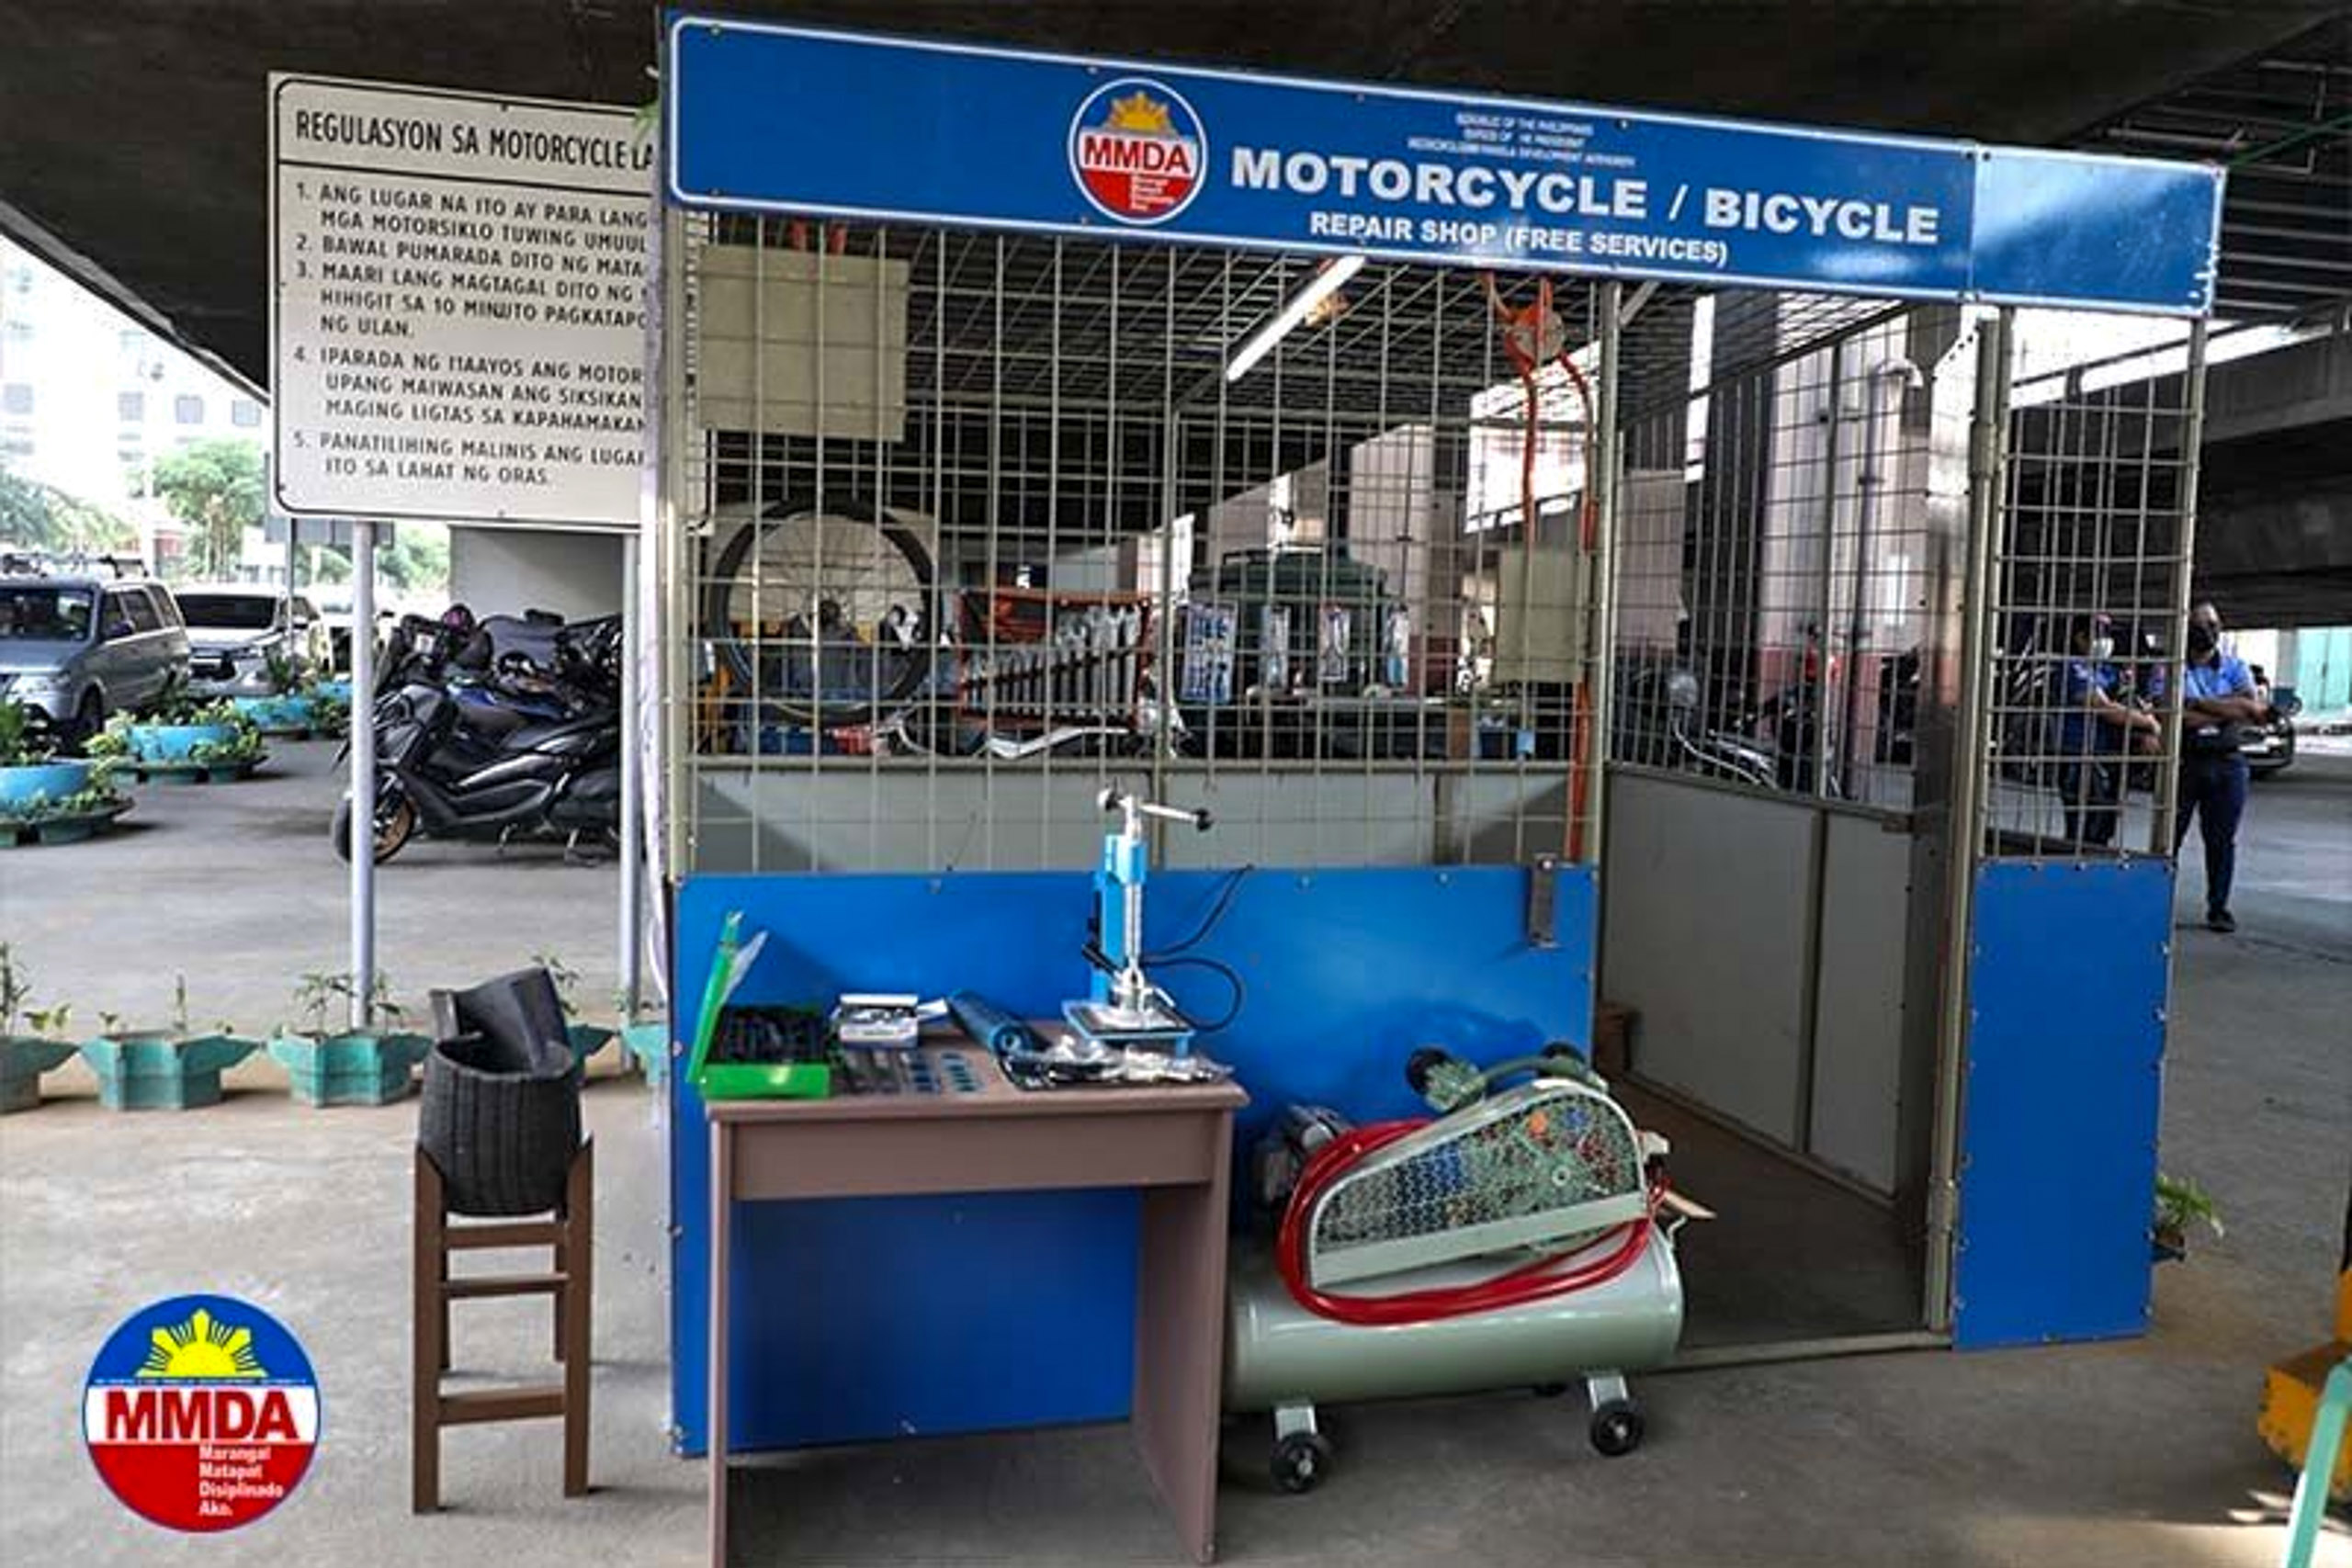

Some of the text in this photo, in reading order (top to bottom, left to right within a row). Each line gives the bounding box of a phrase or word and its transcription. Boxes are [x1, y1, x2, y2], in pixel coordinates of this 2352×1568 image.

[296, 110, 441, 152] REGULASYON
[452, 124, 480, 154] SA
[490, 129, 626, 168] MOTORCYCLE
[1083, 136, 1191, 173] MMDA
[320, 184, 362, 205] ANG
[369, 188, 433, 210] LUGAR
[441, 195, 467, 213] NA
[476, 197, 505, 217] ITO
[514, 202, 537, 220] AY
[544, 204, 593, 224] PARA
[599, 210, 648, 229] LANG
[1231, 146, 1647, 219] MOTORCYCLE
[1668, 184, 1689, 220] /
[1704, 187, 1940, 245] BICYCLE
[322, 210, 363, 229] MGA
[372, 214, 492, 240] MOTORSIKLO
[503, 225, 576, 248] TUWING
[1310, 211, 1727, 268] REPAIR SHOP (FREE SERVICES)
[323, 235, 387, 258] BAWAL
[397, 241, 502, 265] PUMARADA
[511, 251, 553, 271] DITO
[562, 255, 588, 274] NG
[322, 288, 392, 310] HIHIGIT
[402, 294, 424, 311] SA
[435, 297, 455, 315] 10
[323, 263, 383, 283] MAARI
[393, 268, 442, 288] LANG
[452, 273, 546, 296] MAGTAGAL
[556, 280, 599, 300] DITO
[607, 285, 632, 302] NG
[321, 315, 348, 333] NG
[320, 347, 404, 368] IPARADA
[413, 353, 440, 371] NG
[532, 361, 571, 379] ANG
[579, 364, 642, 385] MOTOR
[326, 373, 642, 408] UPANG MAIWASAN ANG SIKSIKAN
[325, 400, 403, 420] MAGING
[412, 403, 474, 424] LIGTAS
[481, 408, 504, 424] SA
[320, 432, 453, 457] PANATILIHING
[461, 439, 536, 461] MALINIS
[544, 445, 582, 463] ANG
[325, 458, 356, 475] ITO
[366, 459, 389, 477] SA
[397, 461, 454, 479] LAHAT
[464, 463, 489, 482] NG
